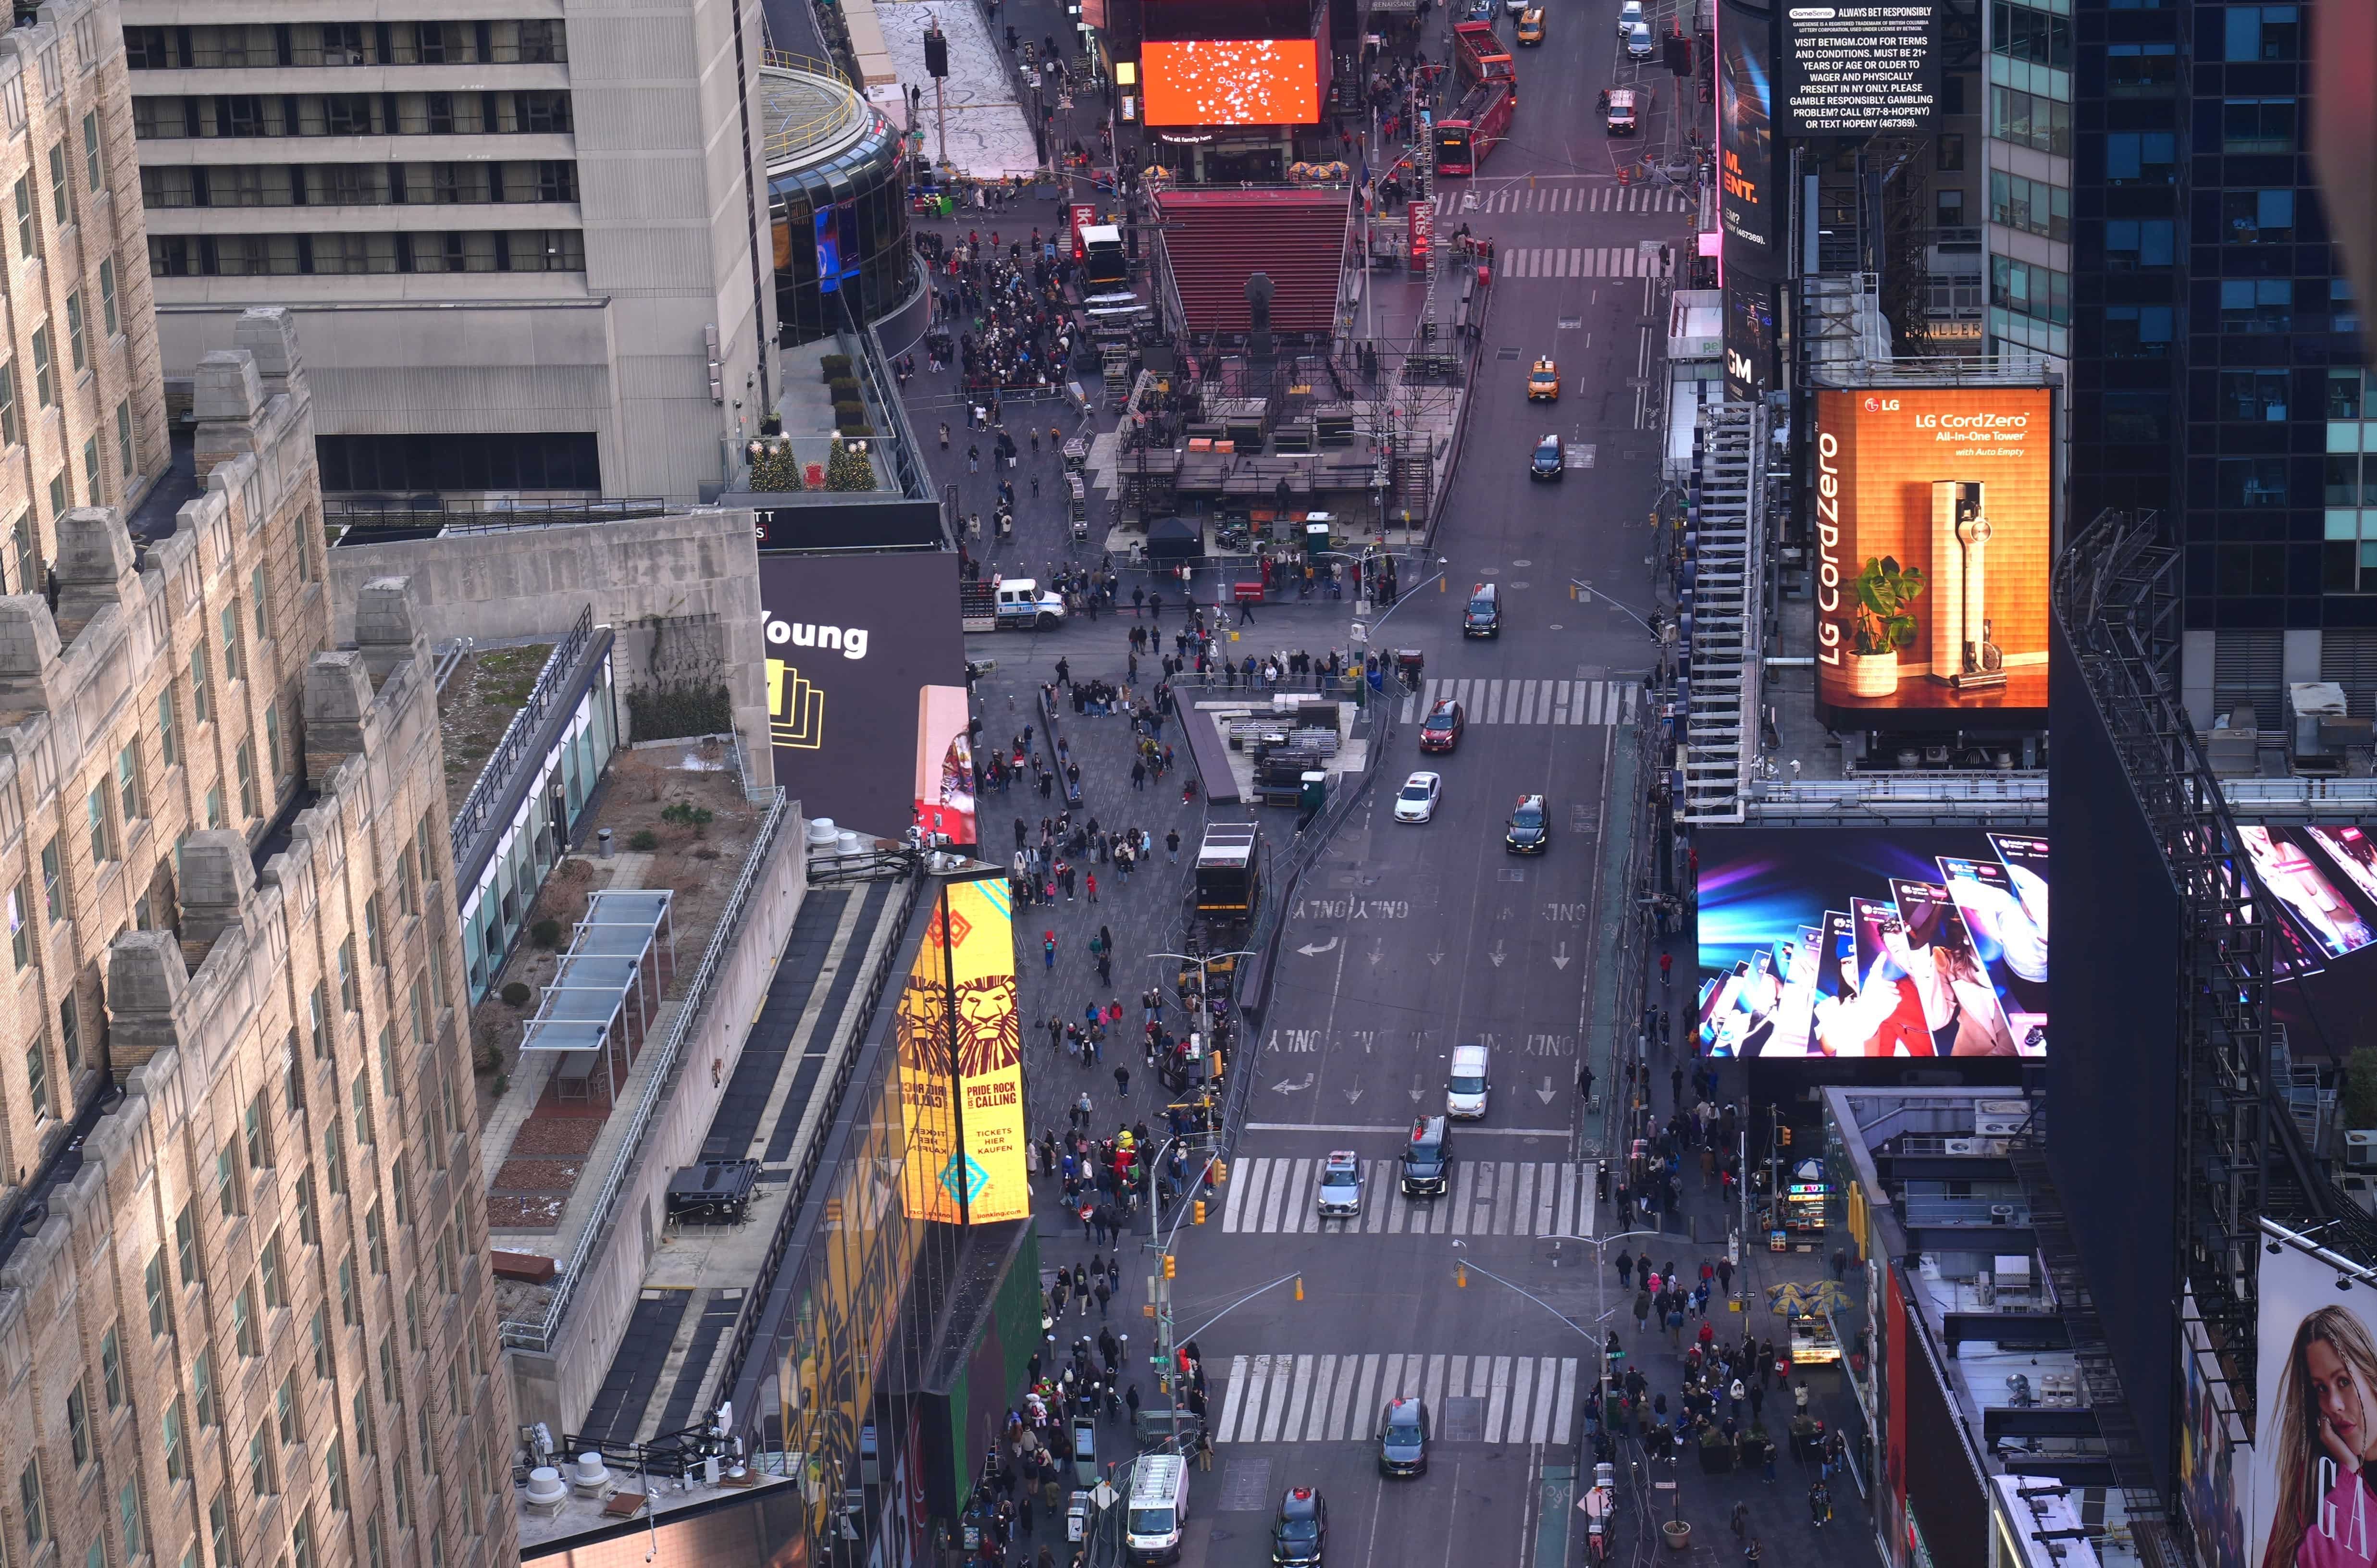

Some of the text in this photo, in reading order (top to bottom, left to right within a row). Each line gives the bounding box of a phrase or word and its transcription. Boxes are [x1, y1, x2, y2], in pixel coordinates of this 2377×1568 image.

[1838, 8, 1867, 17] ALWAYS
[1869, 7, 1882, 17] BET
[1883, 7, 1931, 16] RESPONSIBLY
[1795, 38, 1816, 47] VISIT
[1819, 37, 1877, 47] BETMGM.COM
[1898, 37, 1928, 45] TERMS
[1816, 49, 1872, 58] CONDITIONS.
[1874, 49, 1898, 57] MUST
[1913, 49, 1927, 57] 21+
[1803, 62, 1830, 70] YEARS
[1832, 62, 1844, 70] OF
[1845, 61, 1862, 69] AGE
[1865, 61, 1877, 69] OR
[1879, 61, 1906, 69] OLDER
[1810, 73, 1913, 82] WAGER AND PHYSICALLY
[1801, 85, 1838, 93] PRESENT
[1852, 85, 1863, 93] NY
[1865, 84, 1889, 93] ONLY.
[1891, 84, 1922, 92] PLEASE
[1790, 96, 1933, 105] GAMBLE RESPONSIBLY. GAMBLING
[1794, 107, 1930, 117] PROBLEM? CALL (877-8-HOPENY)
[1806, 118, 1918, 128] OR TEXT HOPENY (467369).
[1724, 171, 1757, 203] ENT.
[1736, 227, 1766, 245] (467369).
[1928, 324, 1981, 335] ILLER
[1727, 348, 1751, 384] GM
[1882, 399, 1900, 411] LG
[1916, 415, 1936, 428] LG
[1936, 432, 1991, 442] All-In-One
[1997, 448, 2025, 457] Empty
[1818, 620, 1840, 666] LG
[967, 1081, 1015, 1097] PRIDE ROCK
[976, 1092, 1016, 1108] CALLING
[977, 1128, 1012, 1137] TICKETS
[978, 1145, 1013, 1154] KAUFEN
[977, 1209, 1021, 1220] lionking.com
[2317, 1457, 2370, 1561] GA
